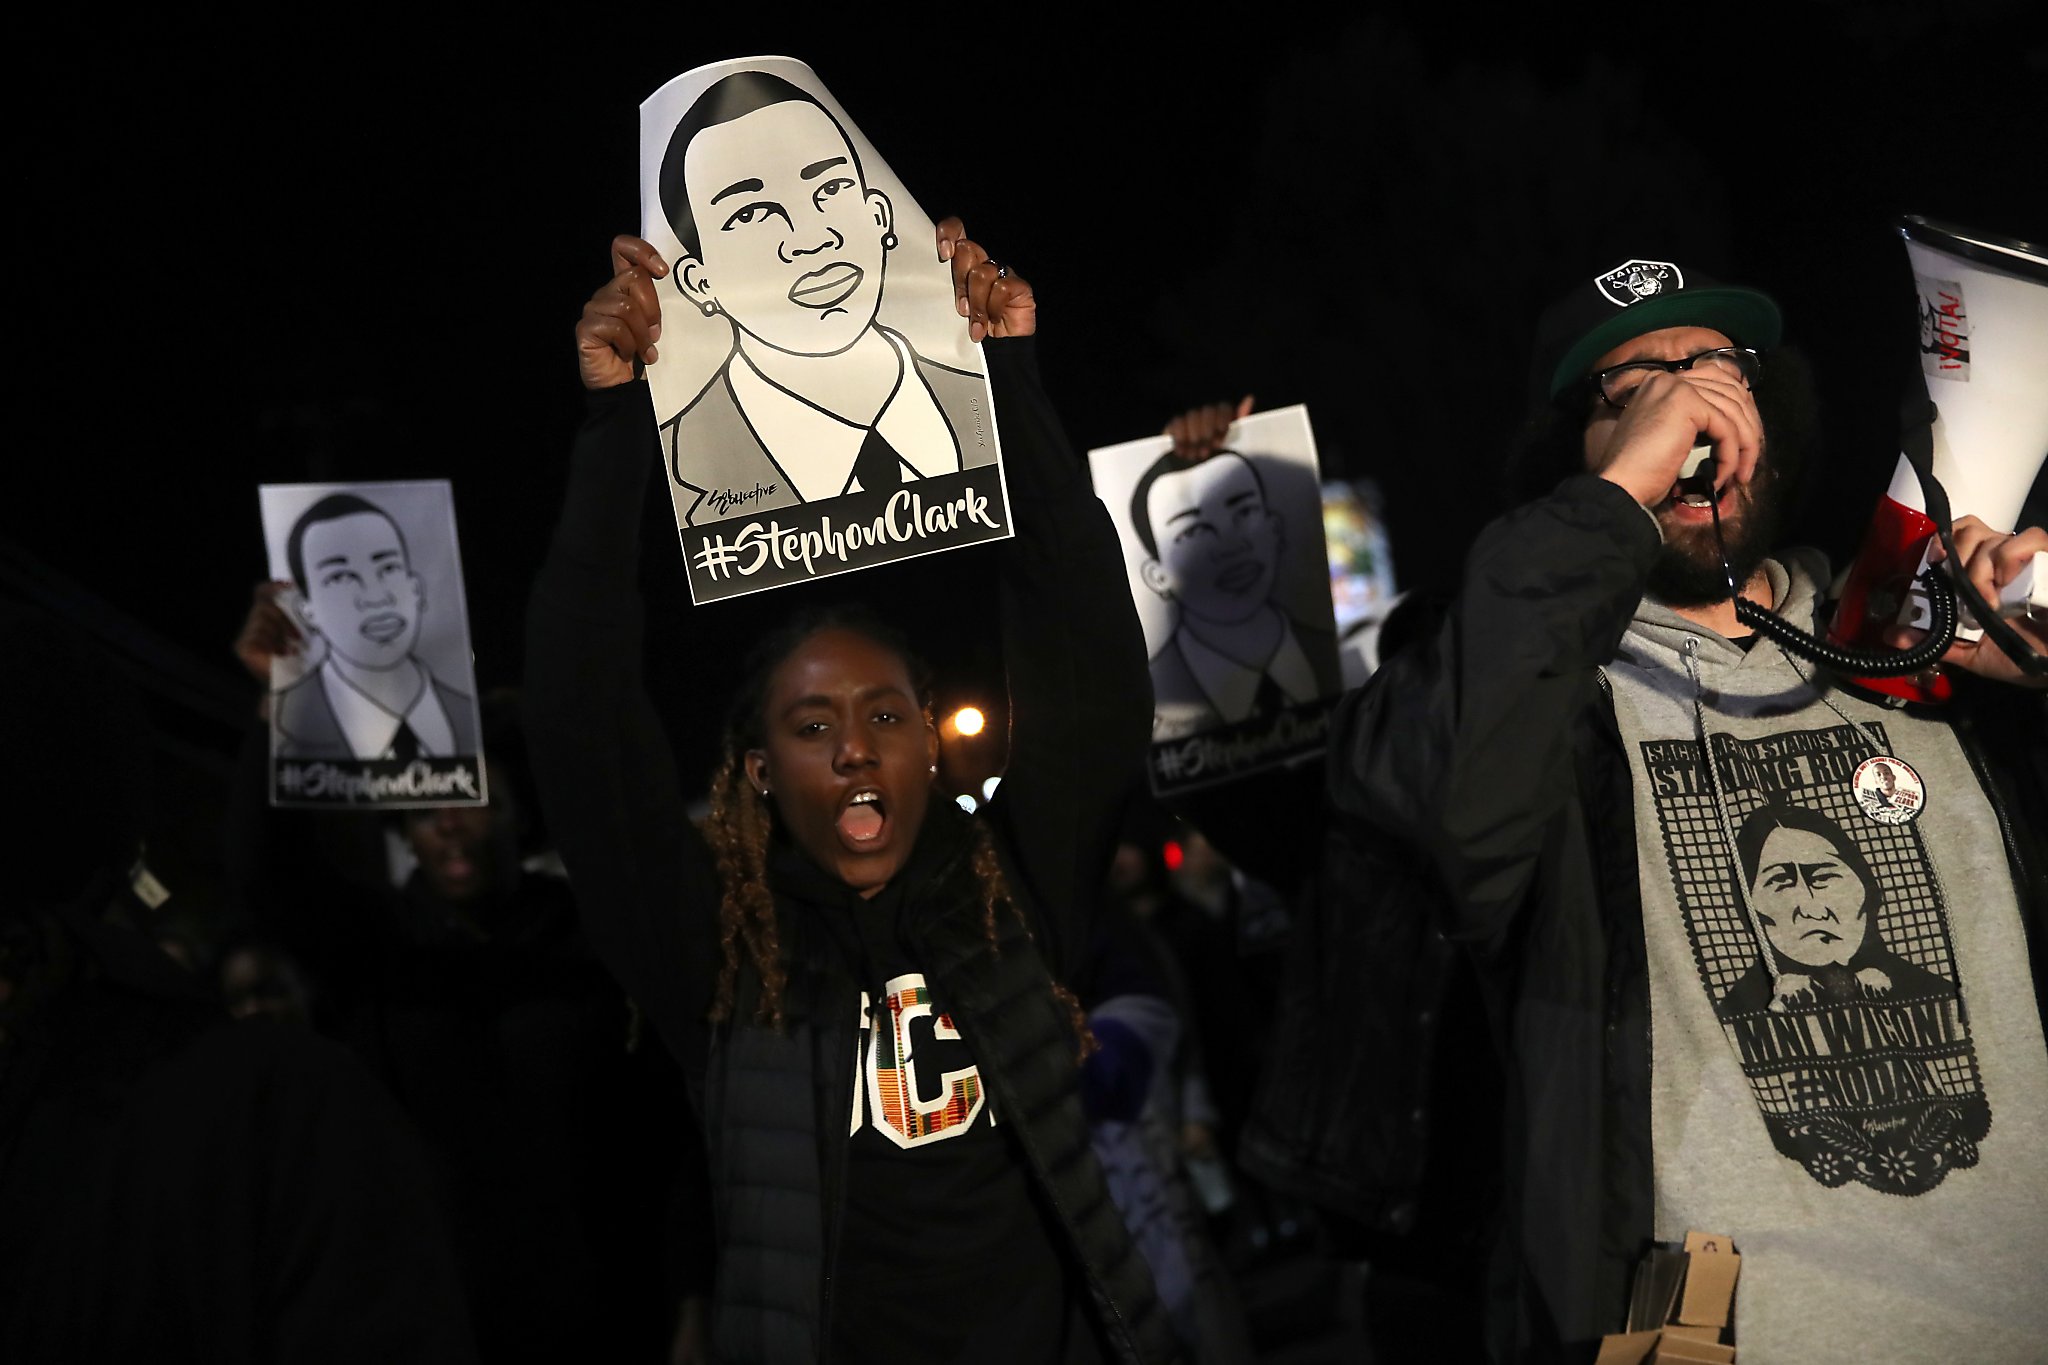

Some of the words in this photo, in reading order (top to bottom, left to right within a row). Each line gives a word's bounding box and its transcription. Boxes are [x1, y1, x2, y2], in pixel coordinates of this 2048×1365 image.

[1606, 264, 1668, 281] RAIDERS
[692, 487, 1001, 581] #StephonClark
[1647, 736, 1758, 763] SACRMENTO
[1761, 729, 1837, 759] STANDS
[280, 760, 480, 801] #StephonClark
[1653, 757, 1804, 798] STANDING
[1808, 746, 1875, 784] RO
[1732, 1014, 1818, 1063] MNI
